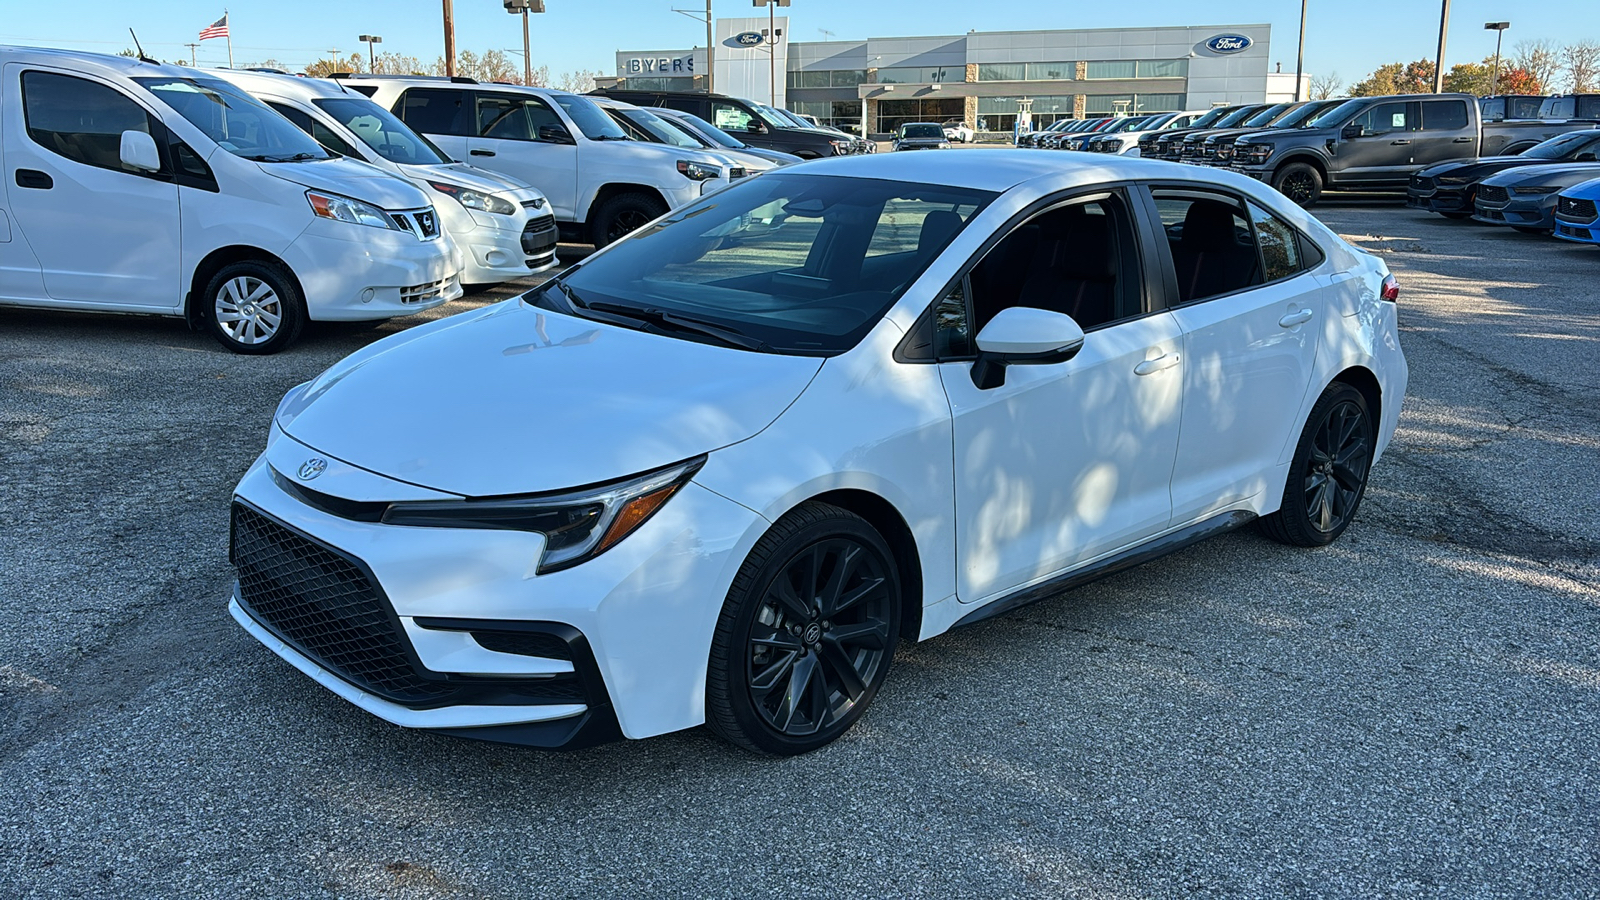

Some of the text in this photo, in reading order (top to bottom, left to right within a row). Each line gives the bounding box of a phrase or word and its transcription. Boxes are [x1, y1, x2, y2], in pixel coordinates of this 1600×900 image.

[741, 35, 759, 43] Ford
[1216, 37, 1243, 49] Ford
[631, 58, 693, 72] BYERS
